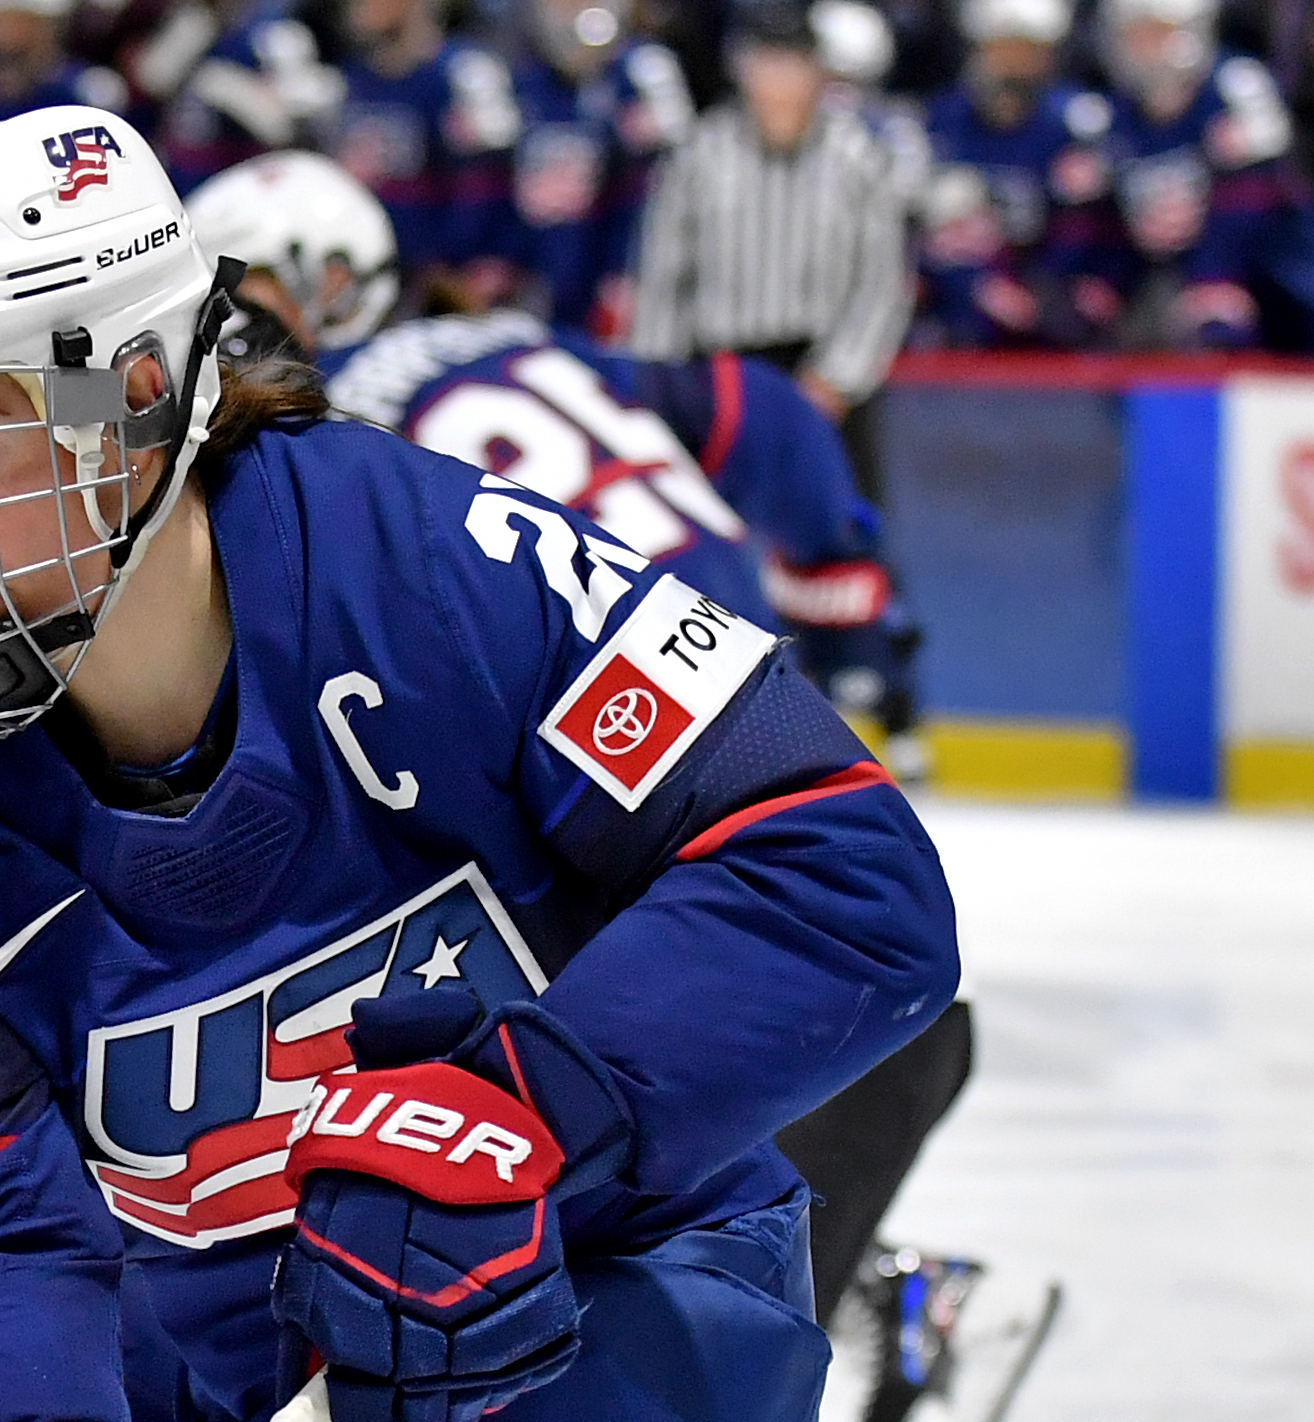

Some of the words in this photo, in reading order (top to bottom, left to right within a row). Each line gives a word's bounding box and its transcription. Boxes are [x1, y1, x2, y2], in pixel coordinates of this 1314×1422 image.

[42, 126, 124, 202] USA
[95, 221, 181, 271] BAUER
[318, 670, 420, 810] C
